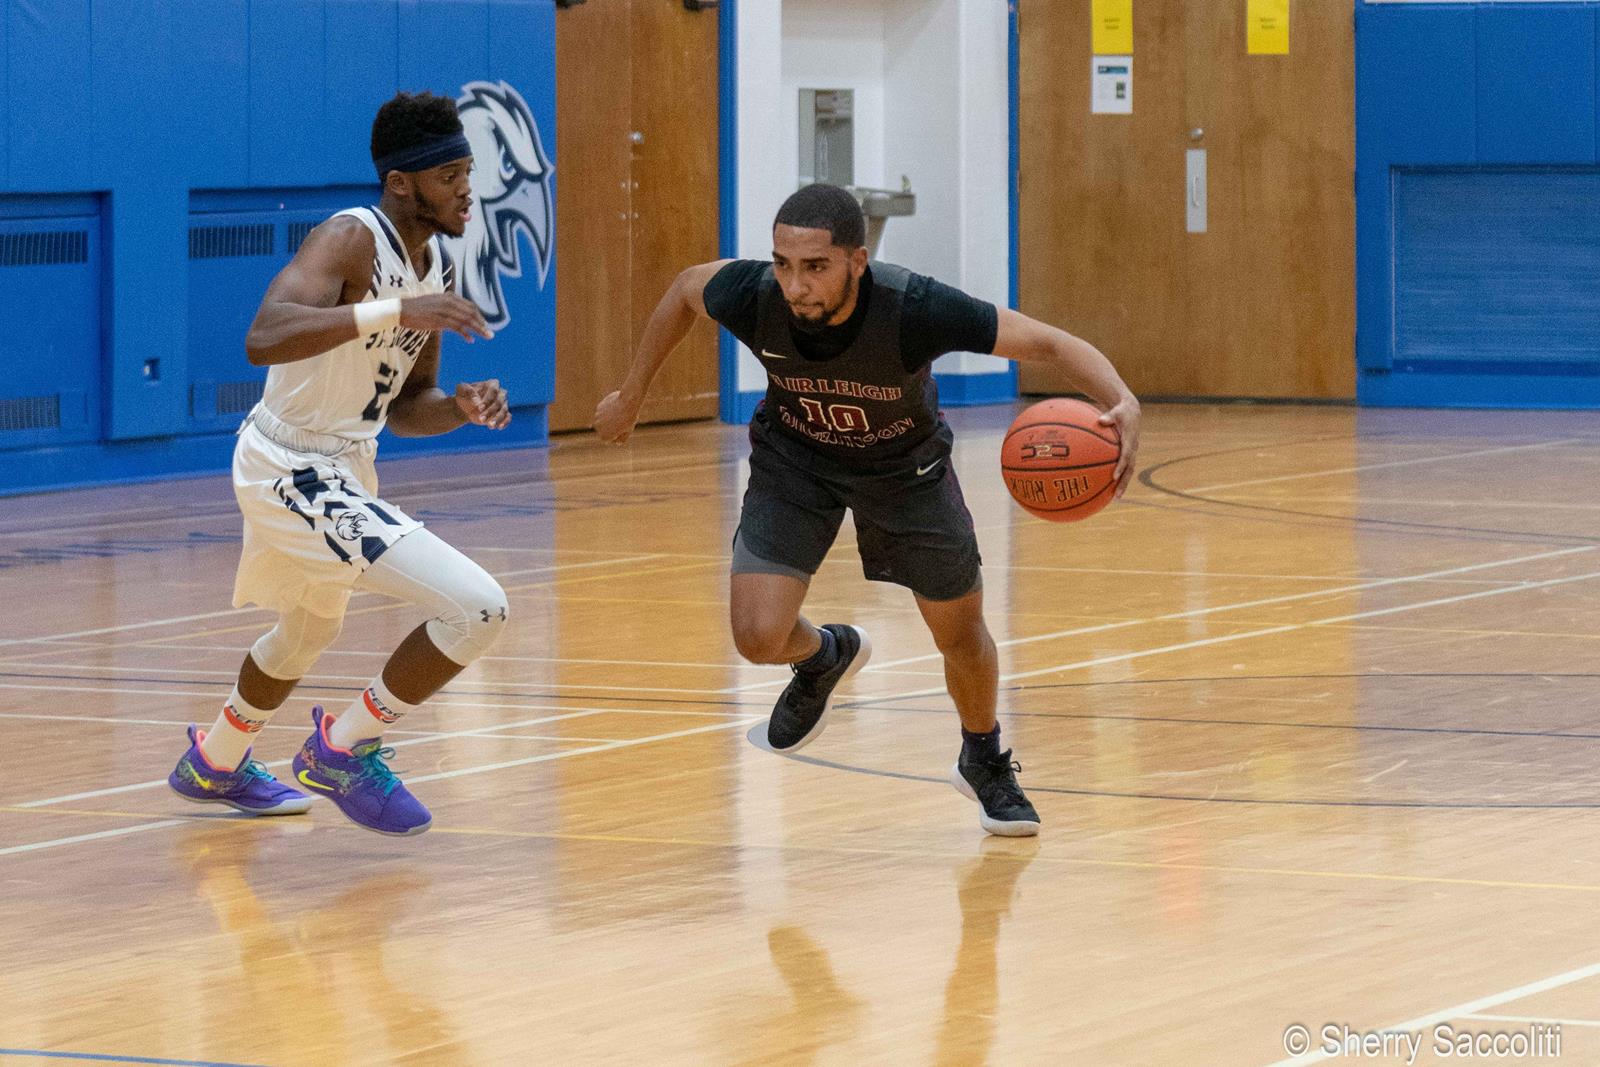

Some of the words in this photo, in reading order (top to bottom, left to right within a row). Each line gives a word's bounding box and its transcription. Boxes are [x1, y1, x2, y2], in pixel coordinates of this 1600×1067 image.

[799, 397, 870, 432] 10
[1054, 475, 1090, 502] THE
[370, 688, 406, 718] PEPS
